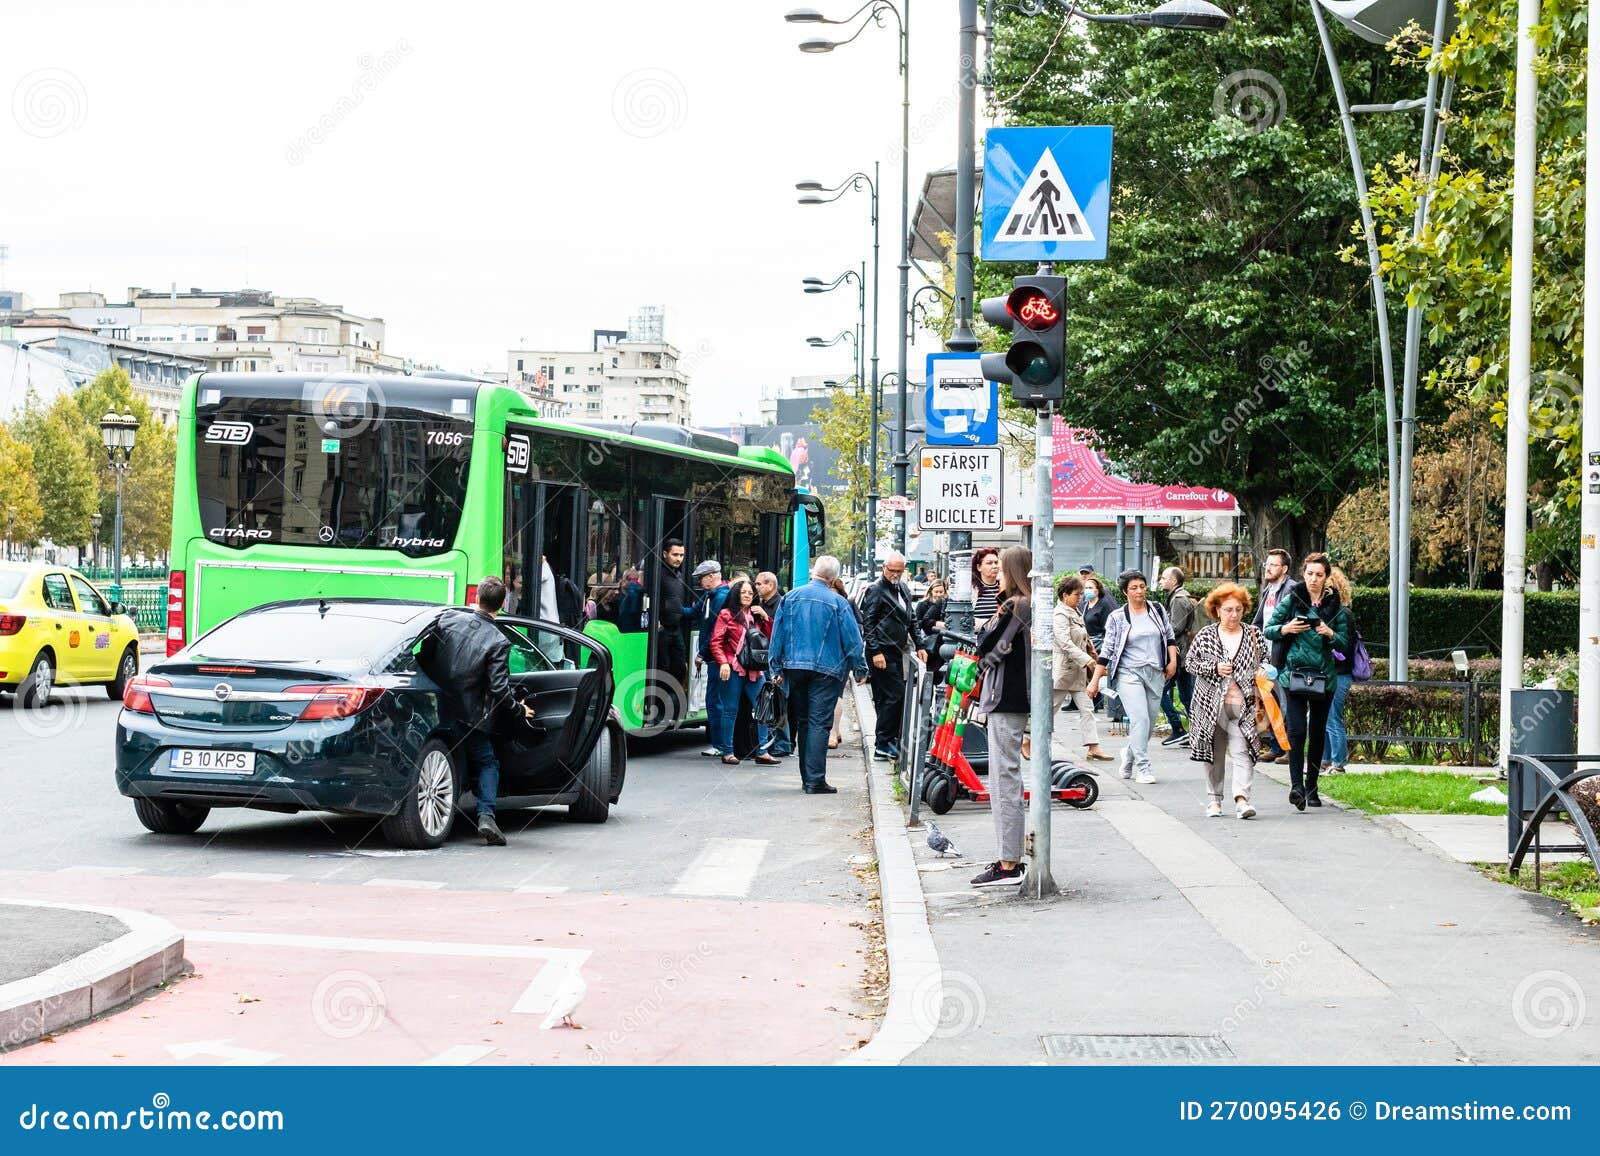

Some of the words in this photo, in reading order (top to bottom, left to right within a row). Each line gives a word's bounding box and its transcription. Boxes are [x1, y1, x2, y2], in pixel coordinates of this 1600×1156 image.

[205, 423, 251, 442] STB
[427, 431, 463, 446] 7056
[507, 438, 529, 469] STB
[933, 452, 989, 471] SFÂRȘIT
[942, 481, 979, 498] PISTĂ
[1166, 491, 1208, 501] Carrefour
[925, 509, 996, 524] BICICLETE
[392, 536, 445, 548] hybrid
[183, 751, 193, 765] B
[198, 751, 211, 766] 10
[215, 753, 246, 768] KPS
